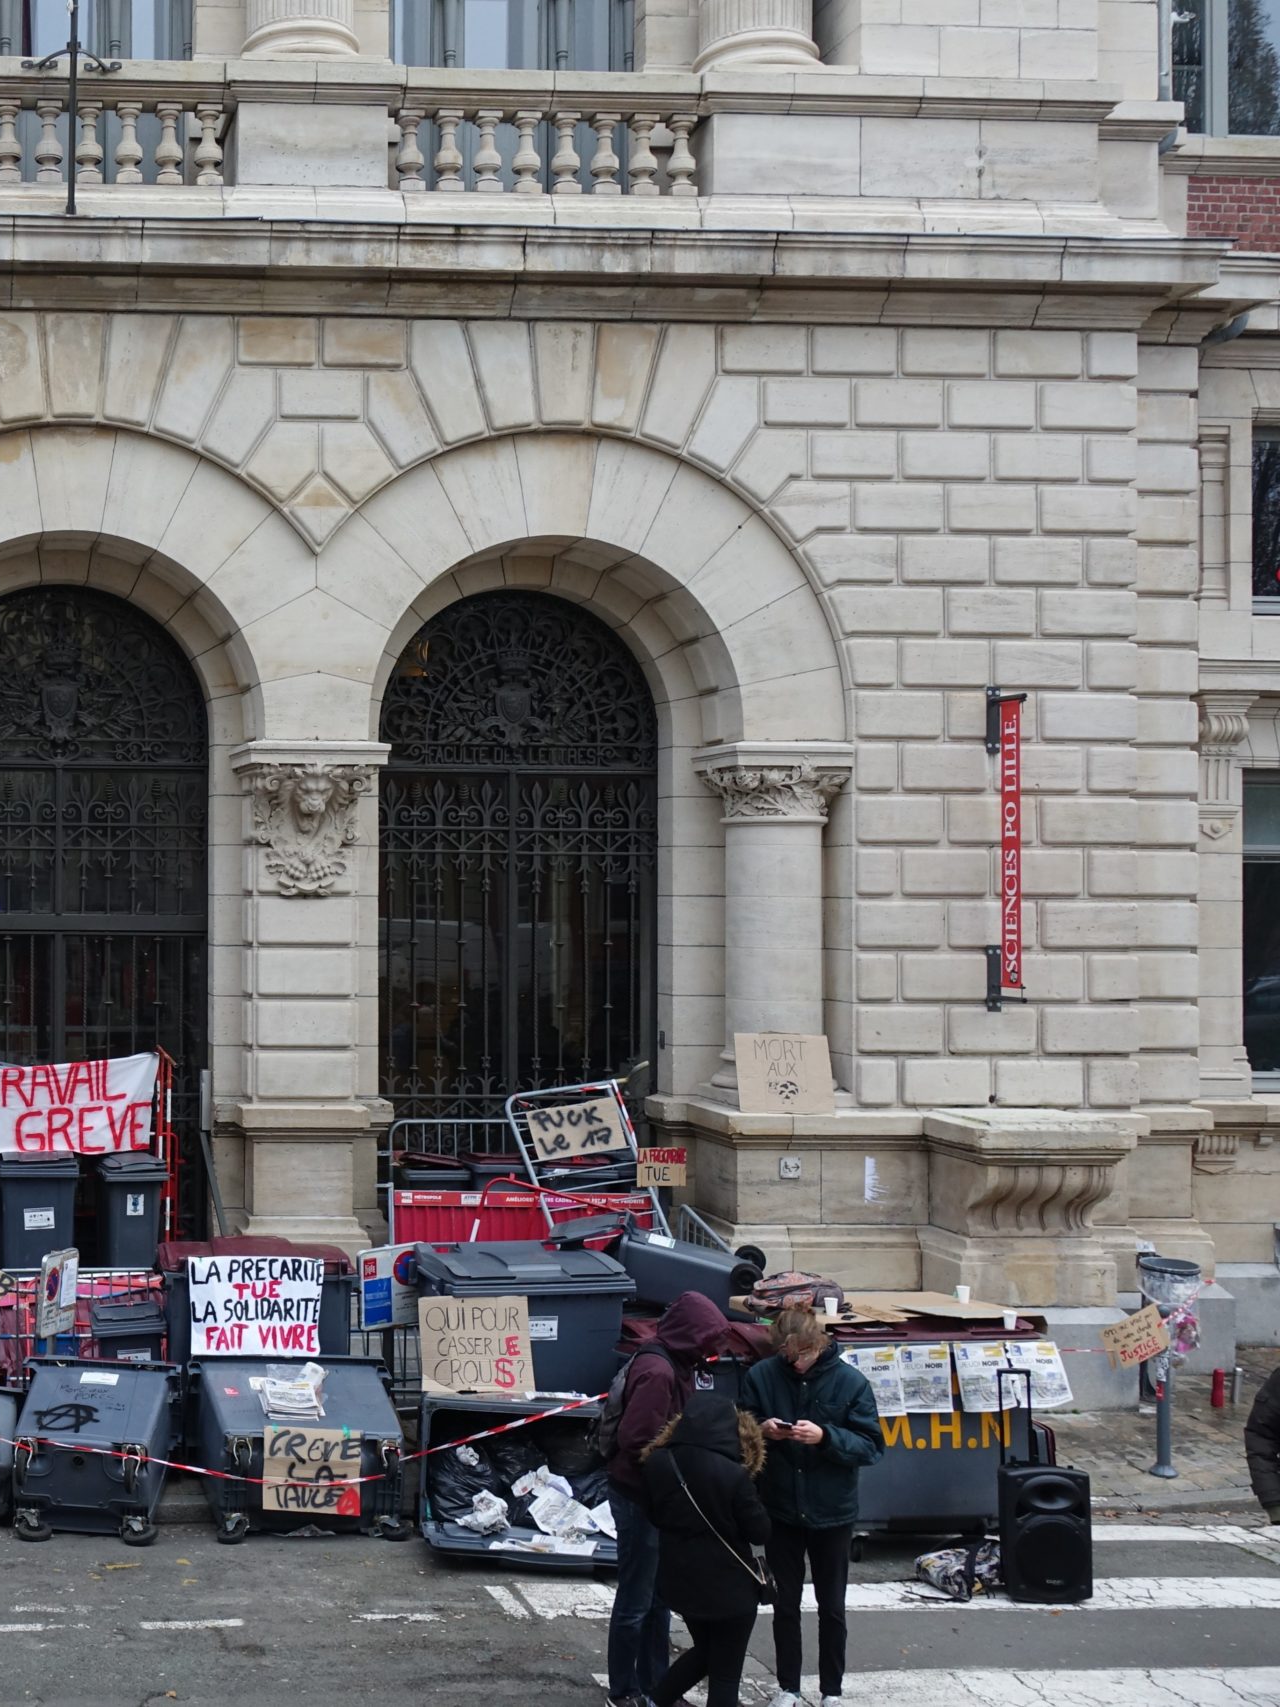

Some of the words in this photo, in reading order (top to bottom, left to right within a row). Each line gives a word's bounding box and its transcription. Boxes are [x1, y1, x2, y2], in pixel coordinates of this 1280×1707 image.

[494, 745, 523, 765] DES
[529, 747, 596, 765] LETTRES
[1005, 802, 1017, 837] PO
[1005, 848, 1017, 972] SCIENCES
[753, 1038, 807, 1061] MORT
[767, 1061, 798, 1077] AUX
[14, 1101, 152, 1153] GREVE
[531, 1105, 604, 1132] FUCK
[637, 1148, 649, 1164] LA
[644, 1166, 671, 1182] TUE
[191, 1260, 221, 1285] LA
[232, 1280, 282, 1300] TUE
[191, 1300, 218, 1323] LA
[223, 1293, 320, 1323] SOLIDARITÉ
[471, 1306, 520, 1331] POUR
[205, 1323, 249, 1351] FAIT
[258, 1323, 318, 1352] VIVRE
[437, 1336, 494, 1356] CASSER
[498, 1335, 521, 1356] LE
[1119, 1336, 1159, 1362] JUSTICE
[517, 1359, 525, 1384] ?
[287, 1461, 348, 1484] LA
